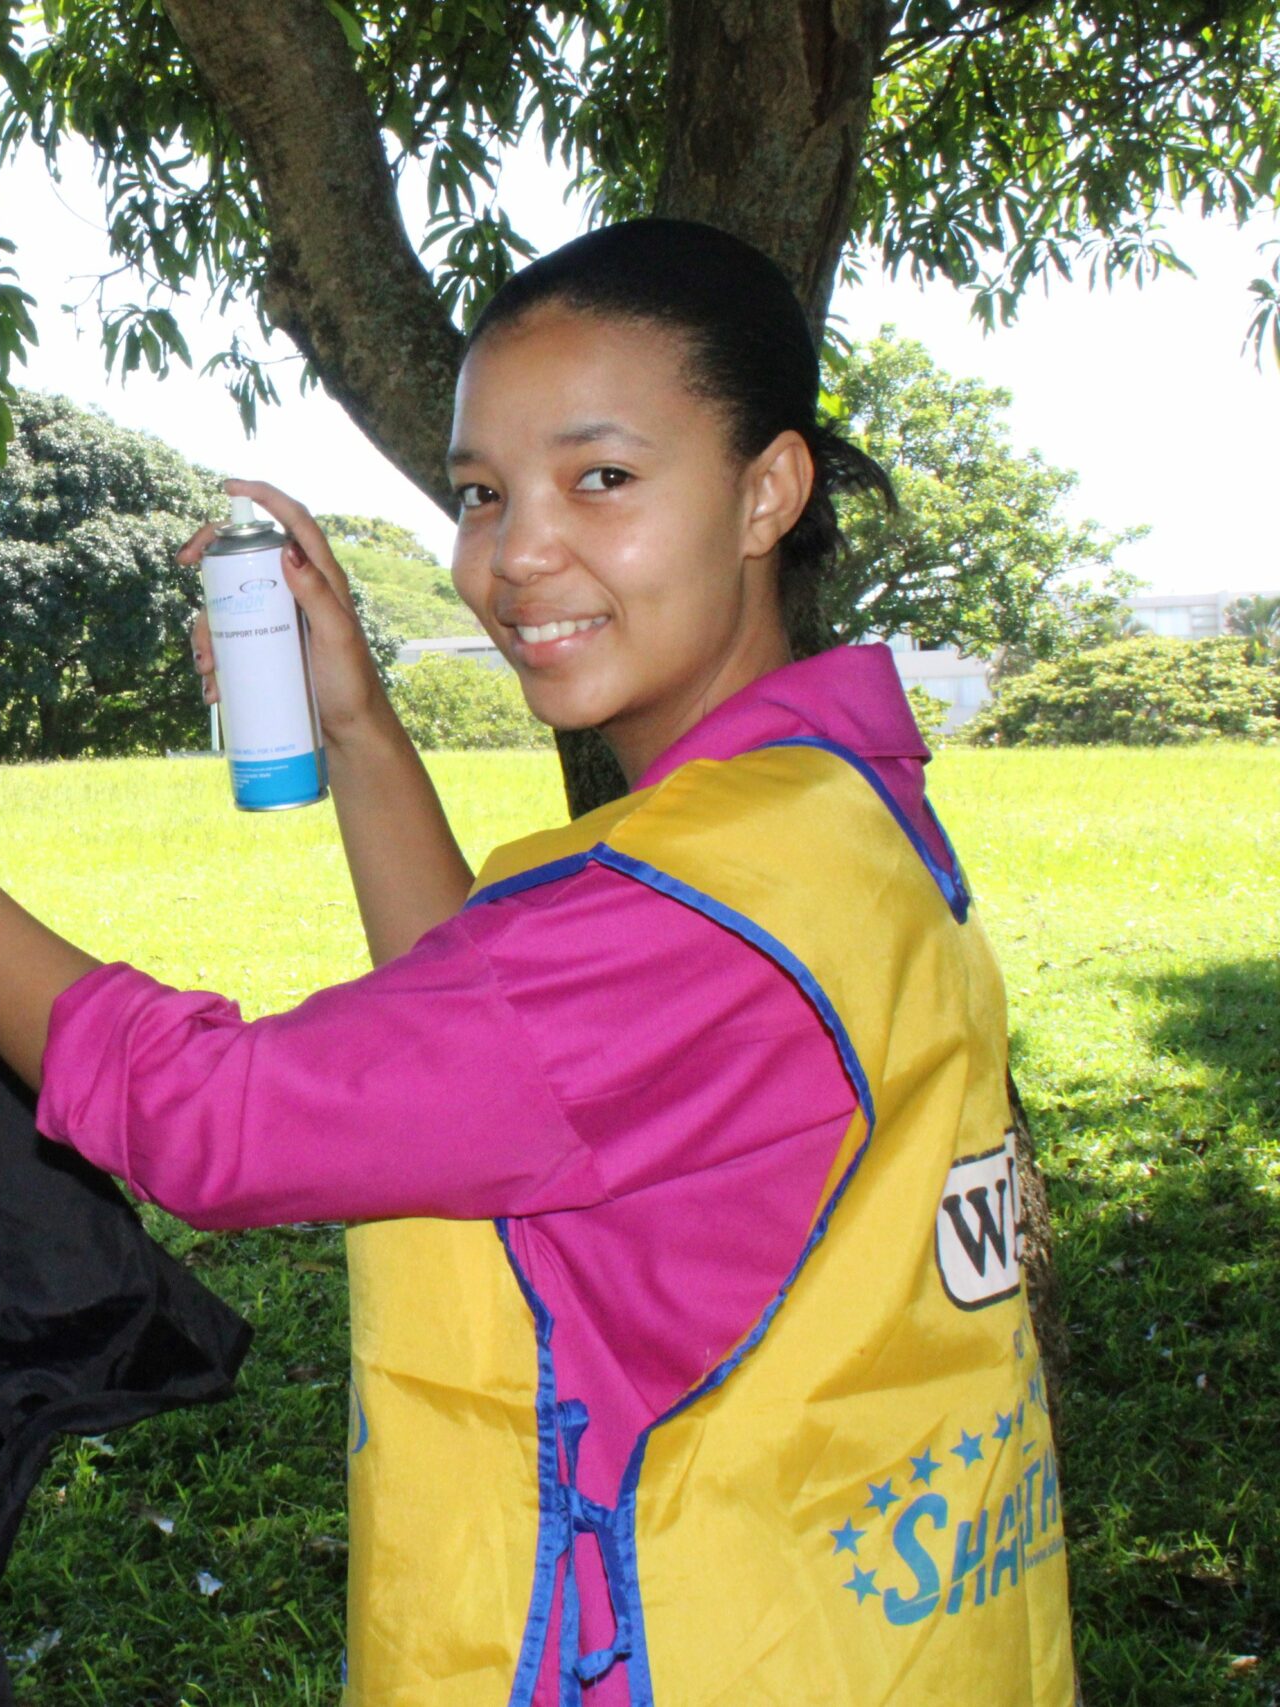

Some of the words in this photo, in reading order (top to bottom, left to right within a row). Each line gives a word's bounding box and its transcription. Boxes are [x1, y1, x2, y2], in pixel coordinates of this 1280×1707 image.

[225, 629, 253, 639] SUPPORT
[255, 626, 269, 636] FOR
[270, 623, 291, 634] CANSA
